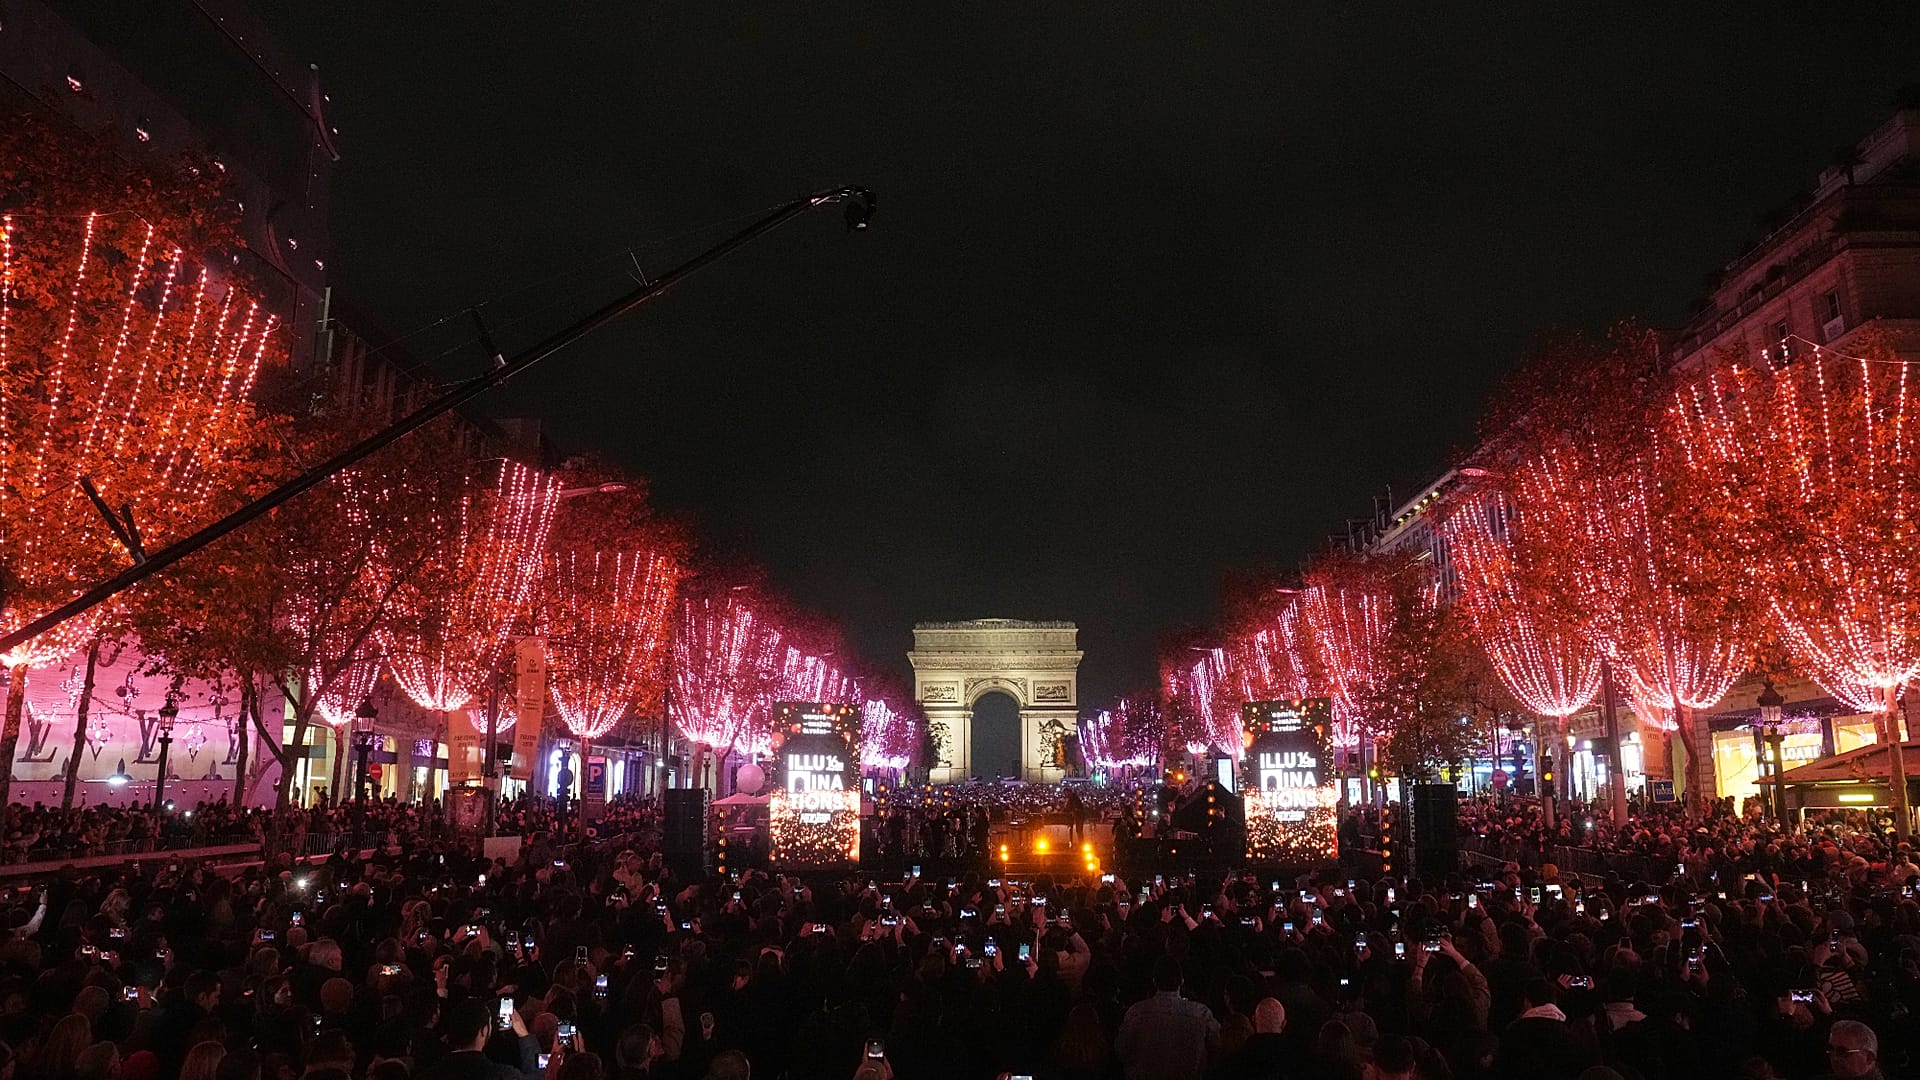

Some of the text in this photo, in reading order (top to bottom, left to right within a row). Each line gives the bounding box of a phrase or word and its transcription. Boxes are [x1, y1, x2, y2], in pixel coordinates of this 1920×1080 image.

[788, 754, 825, 771] ILLU
[1260, 752, 1296, 769] ILLU
[589, 765, 602, 782] P
[789, 793, 844, 810] TIONS
[1262, 791, 1318, 808] TIONS
